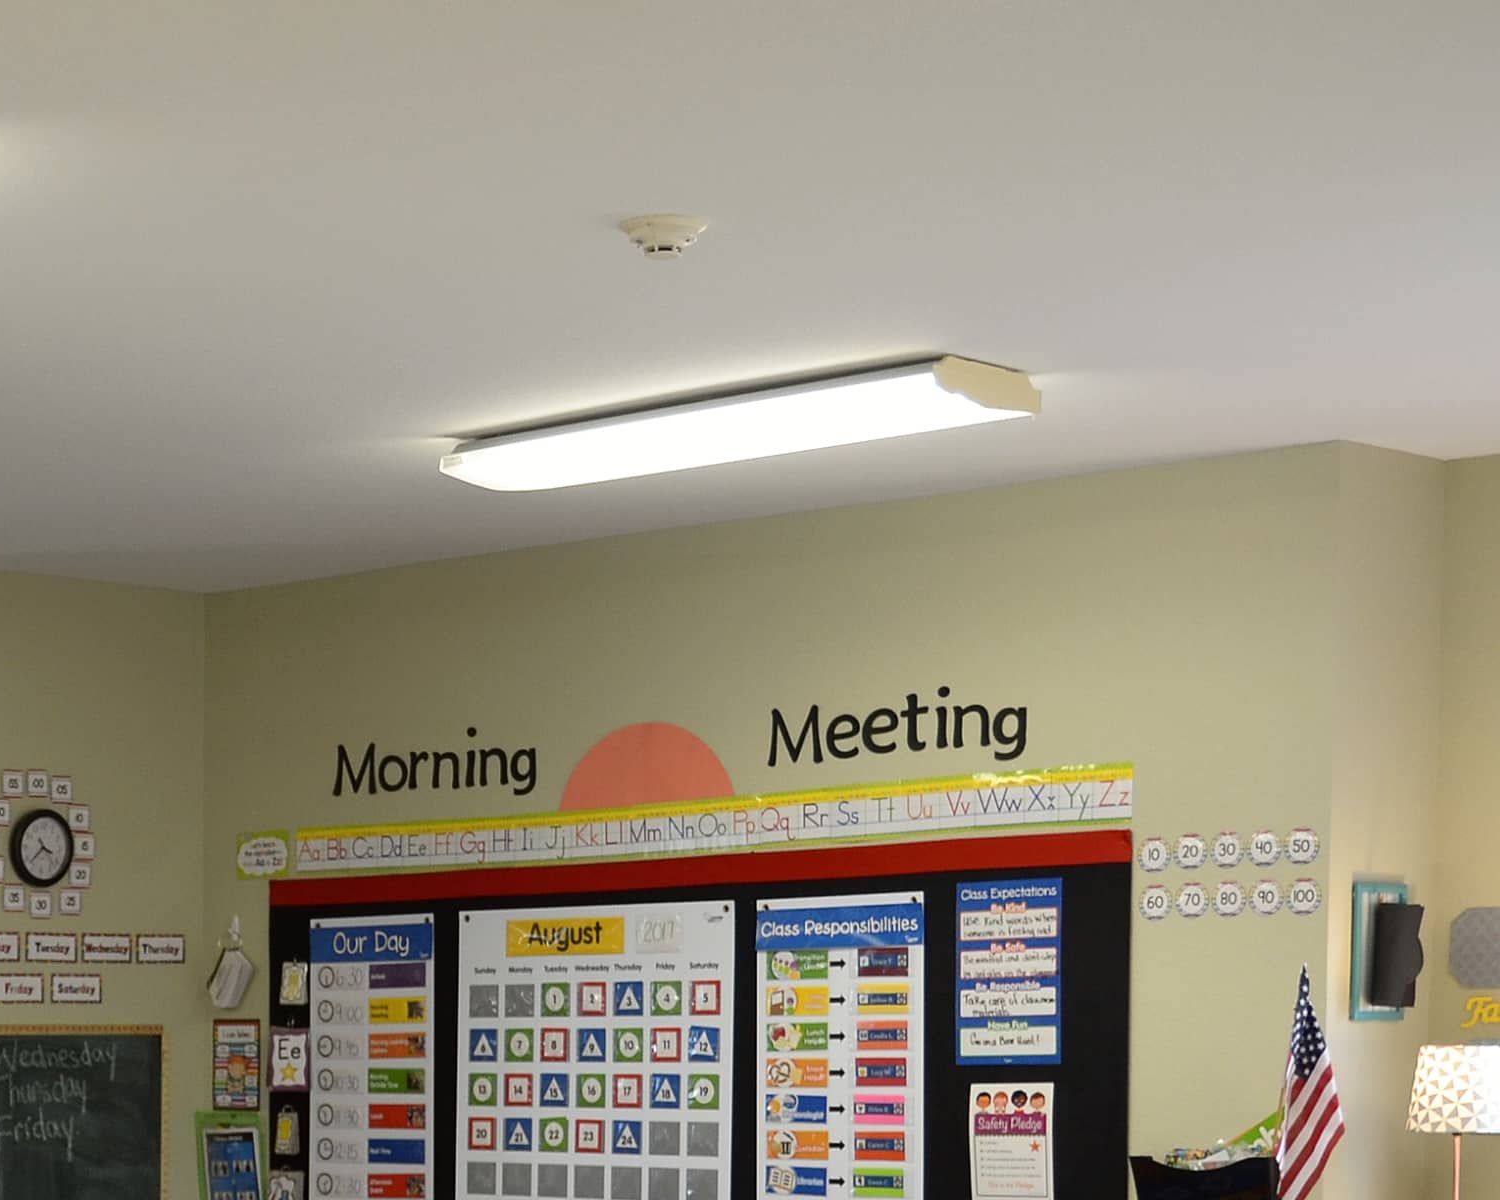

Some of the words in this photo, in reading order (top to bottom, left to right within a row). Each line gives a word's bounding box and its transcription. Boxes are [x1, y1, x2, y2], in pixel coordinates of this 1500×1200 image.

[332, 727, 538, 797] Morning
[767, 686, 1028, 767] Meeting
[301, 838, 320, 861] Aa
[327, 838, 347, 860] Bb
[352, 836, 374, 858] Cc
[381, 835, 402, 857] Dd
[408, 834, 426, 856] Ee
[435, 832, 453, 855] Ff
[460, 831, 485, 863] Gg
[521, 828, 533, 850] Ii
[545, 825, 566, 859] Jj
[575, 823, 599, 846] Kk
[630, 819, 662, 843] Mm
[668, 816, 694, 839] Nn
[699, 813, 727, 837] Oo
[733, 810, 755, 843] Pp
[761, 807, 795, 841] Qq
[803, 803, 829, 829] Rr
[837, 801, 859, 826] Ss
[907, 794, 932, 820] Uu
[947, 790, 971, 816] Vv
[977, 787, 1022, 814] Ww
[1027, 784, 1056, 811] Xx
[1063, 782, 1090, 820] Yy
[1099, 780, 1130, 807] Zz
[1148, 848, 1160, 862] 10
[1182, 845, 1199, 859] 20
[1218, 843, 1236, 857] 30
[1255, 841, 1273, 855] 40
[1292, 839, 1310, 853] 50
[961, 889, 988, 901] Class
[990, 886, 1057, 900] Expectations
[1147, 896, 1163, 909] 60
[1184, 893, 1201, 906] 70
[1220, 891, 1238, 905] 80
[1257, 890, 1275, 904] 90
[1293, 889, 1315, 904] 100
[528, 920, 602, 951] August
[644, 920, 675, 943] 2017
[761, 921, 800, 938] Class
[804, 915, 920, 938] Responsibilities
[35, 941, 70, 955] Tuesday
[85, 942, 129, 956] Wednesday
[142, 943, 180, 956] Thursday
[334, 932, 368, 954] Our
[374, 930, 410, 957] Day
[474, 967, 496, 976] Sunday
[508, 966, 533, 975] Monday
[544, 965, 569, 974] Tuesday
[575, 964, 610, 973] Wednesday
[614, 963, 642, 972] Thursday
[655, 962, 676, 972] Friday
[689, 961, 719, 971] Saturday
[5, 982, 34, 996] Friday
[57, 982, 96, 996] Saturday
[278, 1038, 301, 1061] Ee
[478, 1084, 487, 1095] 13
[514, 1084, 523, 1095] 14
[549, 1088, 558, 1098] 15
[587, 1085, 596, 1096] 16
[623, 1086, 632, 1097] 17
[661, 1090, 671, 1100] 18
[699, 1086, 708, 1097] 19
[978, 1116, 1008, 1133] Safety
[1011, 1116, 1043, 1133] Pledge
[476, 1128, 487, 1139] 20
[514, 1133, 523, 1143] 21
[548, 1130, 559, 1140] 22
[583, 1131, 594, 1142] 23
[621, 1135, 633, 1146] 24
